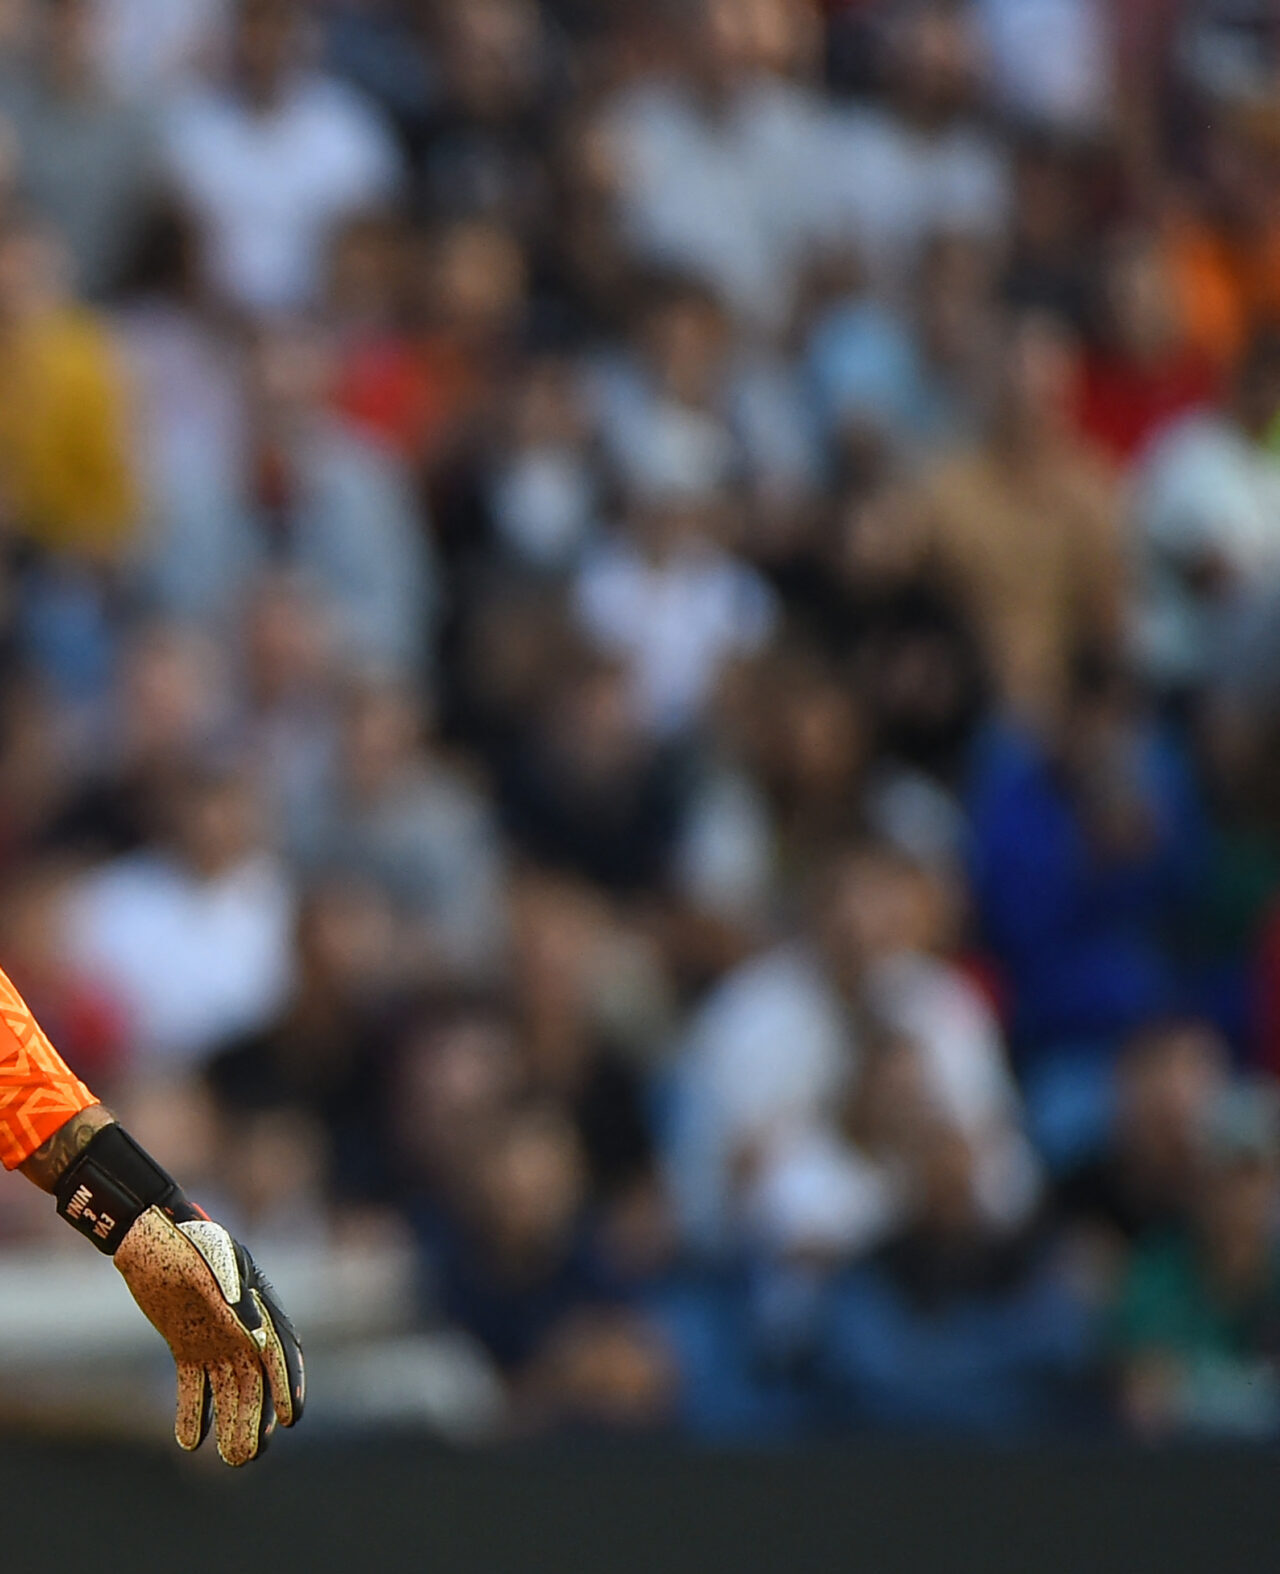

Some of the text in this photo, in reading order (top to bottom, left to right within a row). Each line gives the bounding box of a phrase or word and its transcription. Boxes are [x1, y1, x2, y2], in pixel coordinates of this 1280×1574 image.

[65, 1184, 94, 1220] NINA
[82, 1207, 97, 1222] &
[93, 1212, 116, 1240] EVA
